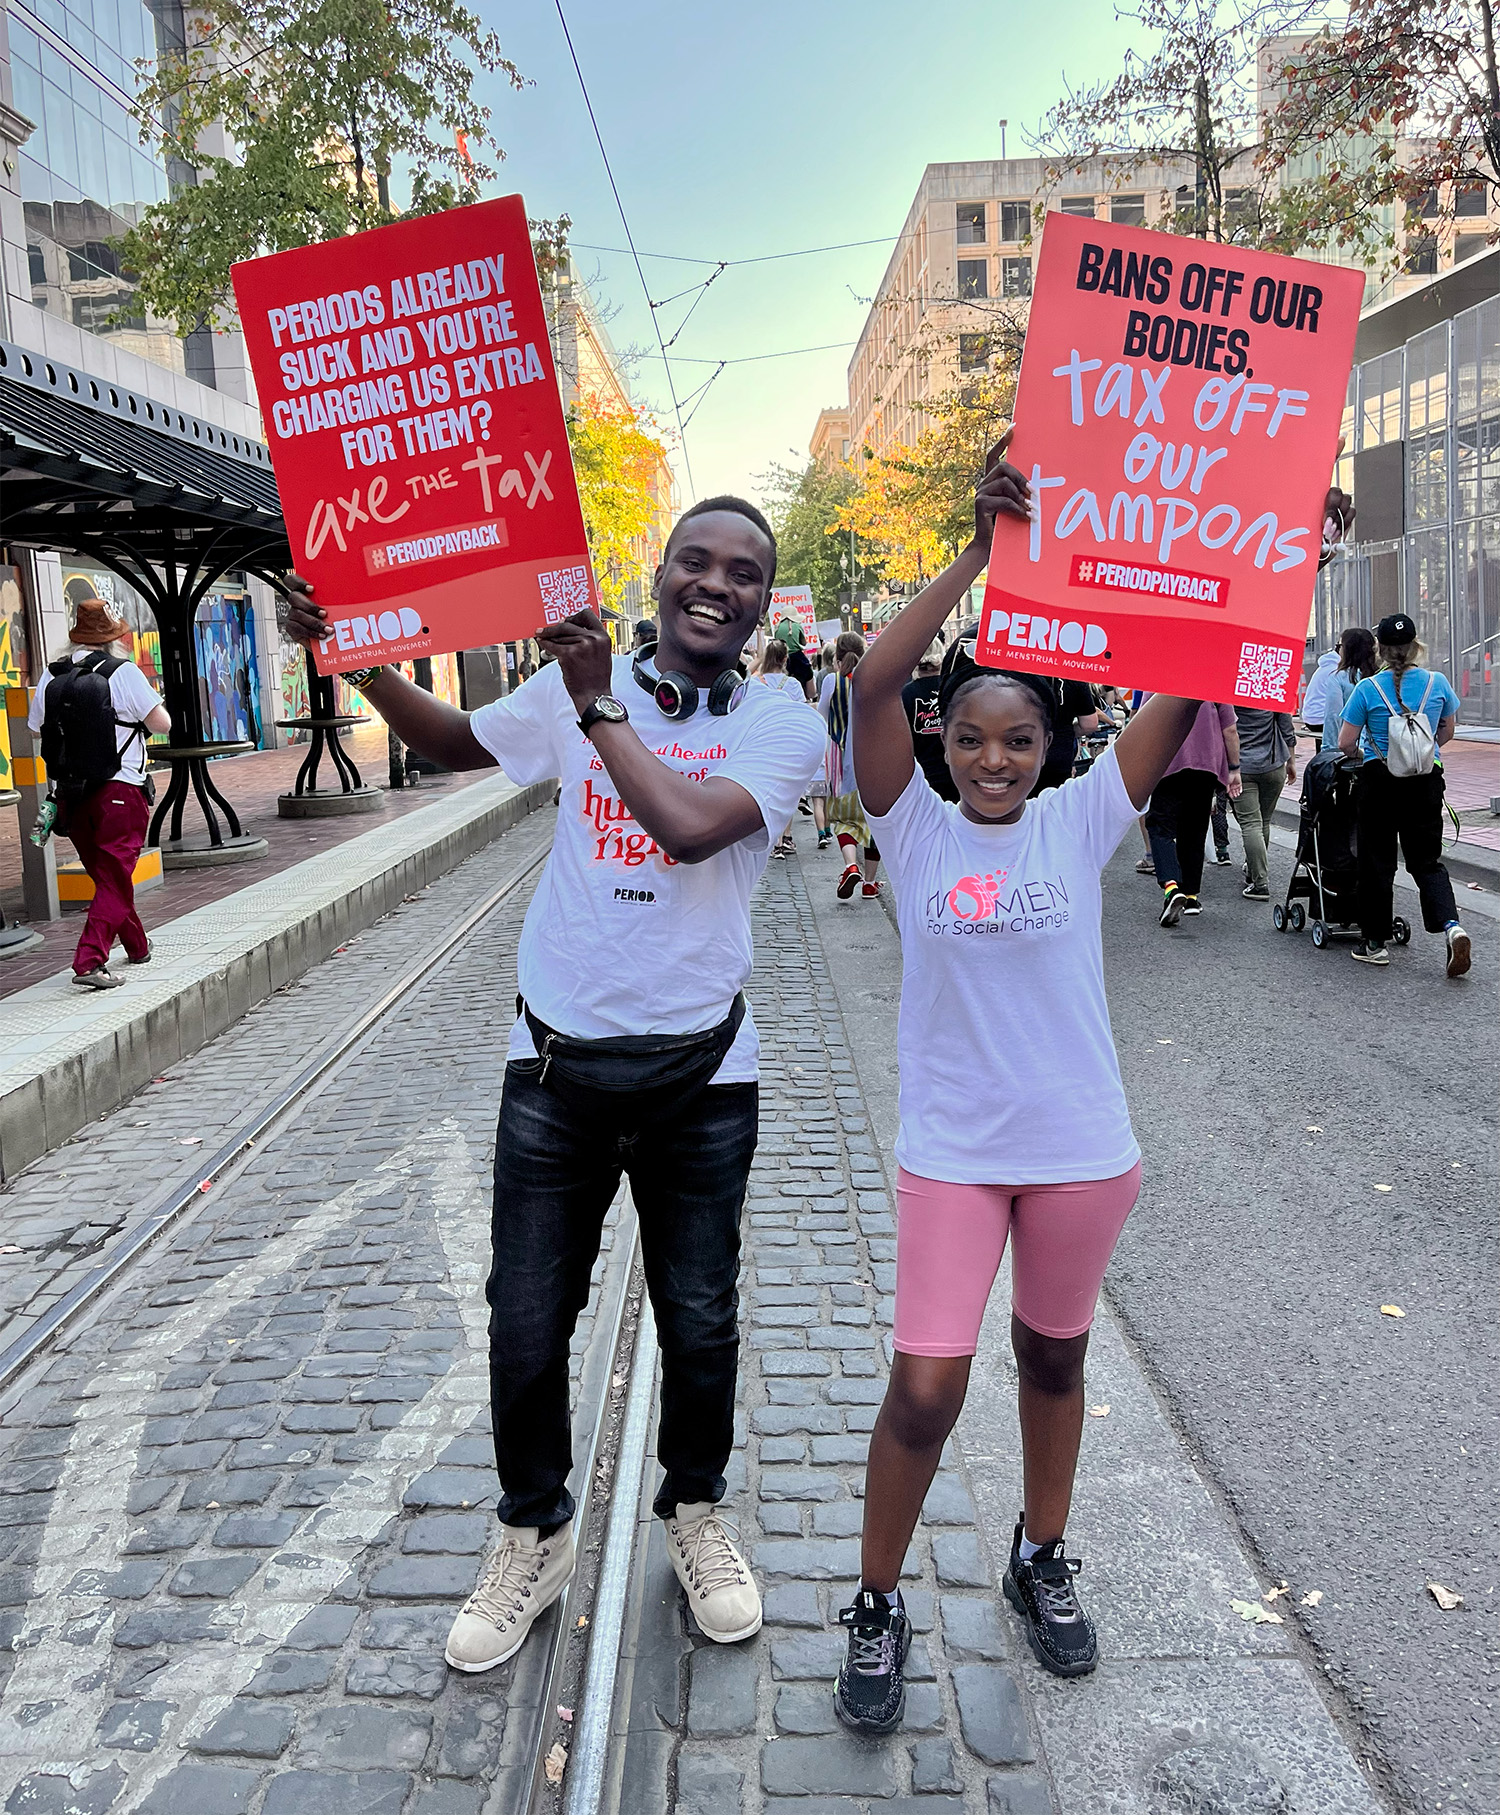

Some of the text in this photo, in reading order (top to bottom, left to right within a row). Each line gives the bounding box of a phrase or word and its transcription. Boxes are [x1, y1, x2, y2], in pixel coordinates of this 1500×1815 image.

[268, 253, 506, 348] PERIODS ALREADY
[1076, 243, 1323, 333] BANS OFF OUR
[279, 300, 518, 391] SUCK AND YOU'RE
[1123, 309, 1254, 379] BODIES.
[272, 342, 546, 439] CHARGING US EXTRA
[340, 400, 494, 470] FOR THEM?
[305, 446, 554, 560] axe THE tax
[371, 523, 501, 569] #PERIODPAYBACK
[773, 592, 807, 605] Support
[1077, 560, 1221, 603] #PERIODPAYBACK
[323, 639, 433, 667] THE MENSTRUAL MOVEMENT
[987, 610, 1112, 659] PERIOD.
[985, 647, 1110, 673] THE MENSTRUAL MOVEMENT
[589, 754, 603, 771] is
[670, 743, 727, 760] health
[951, 920, 1005, 936] Social
[1010, 909, 1070, 932] Change
